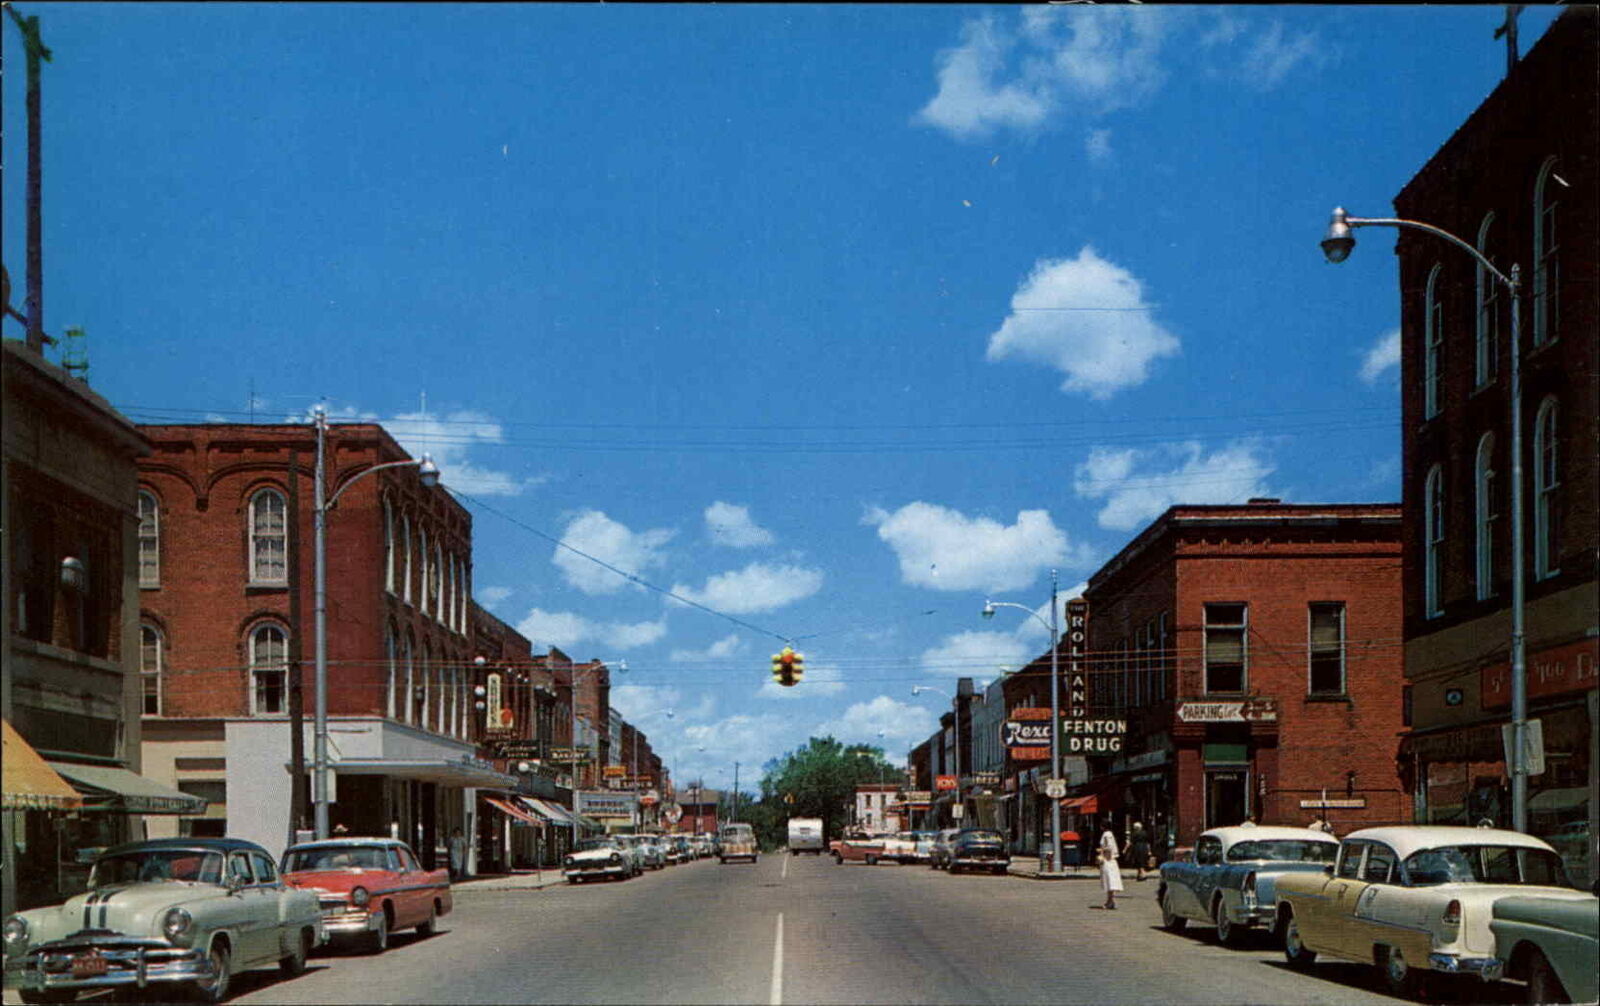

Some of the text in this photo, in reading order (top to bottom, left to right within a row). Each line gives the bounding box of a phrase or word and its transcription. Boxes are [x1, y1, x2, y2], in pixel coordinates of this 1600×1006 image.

[1183, 705, 1223, 719] PARKING
[1063, 720, 1127, 733] FENTON
[1070, 737, 1121, 751] DRUG
